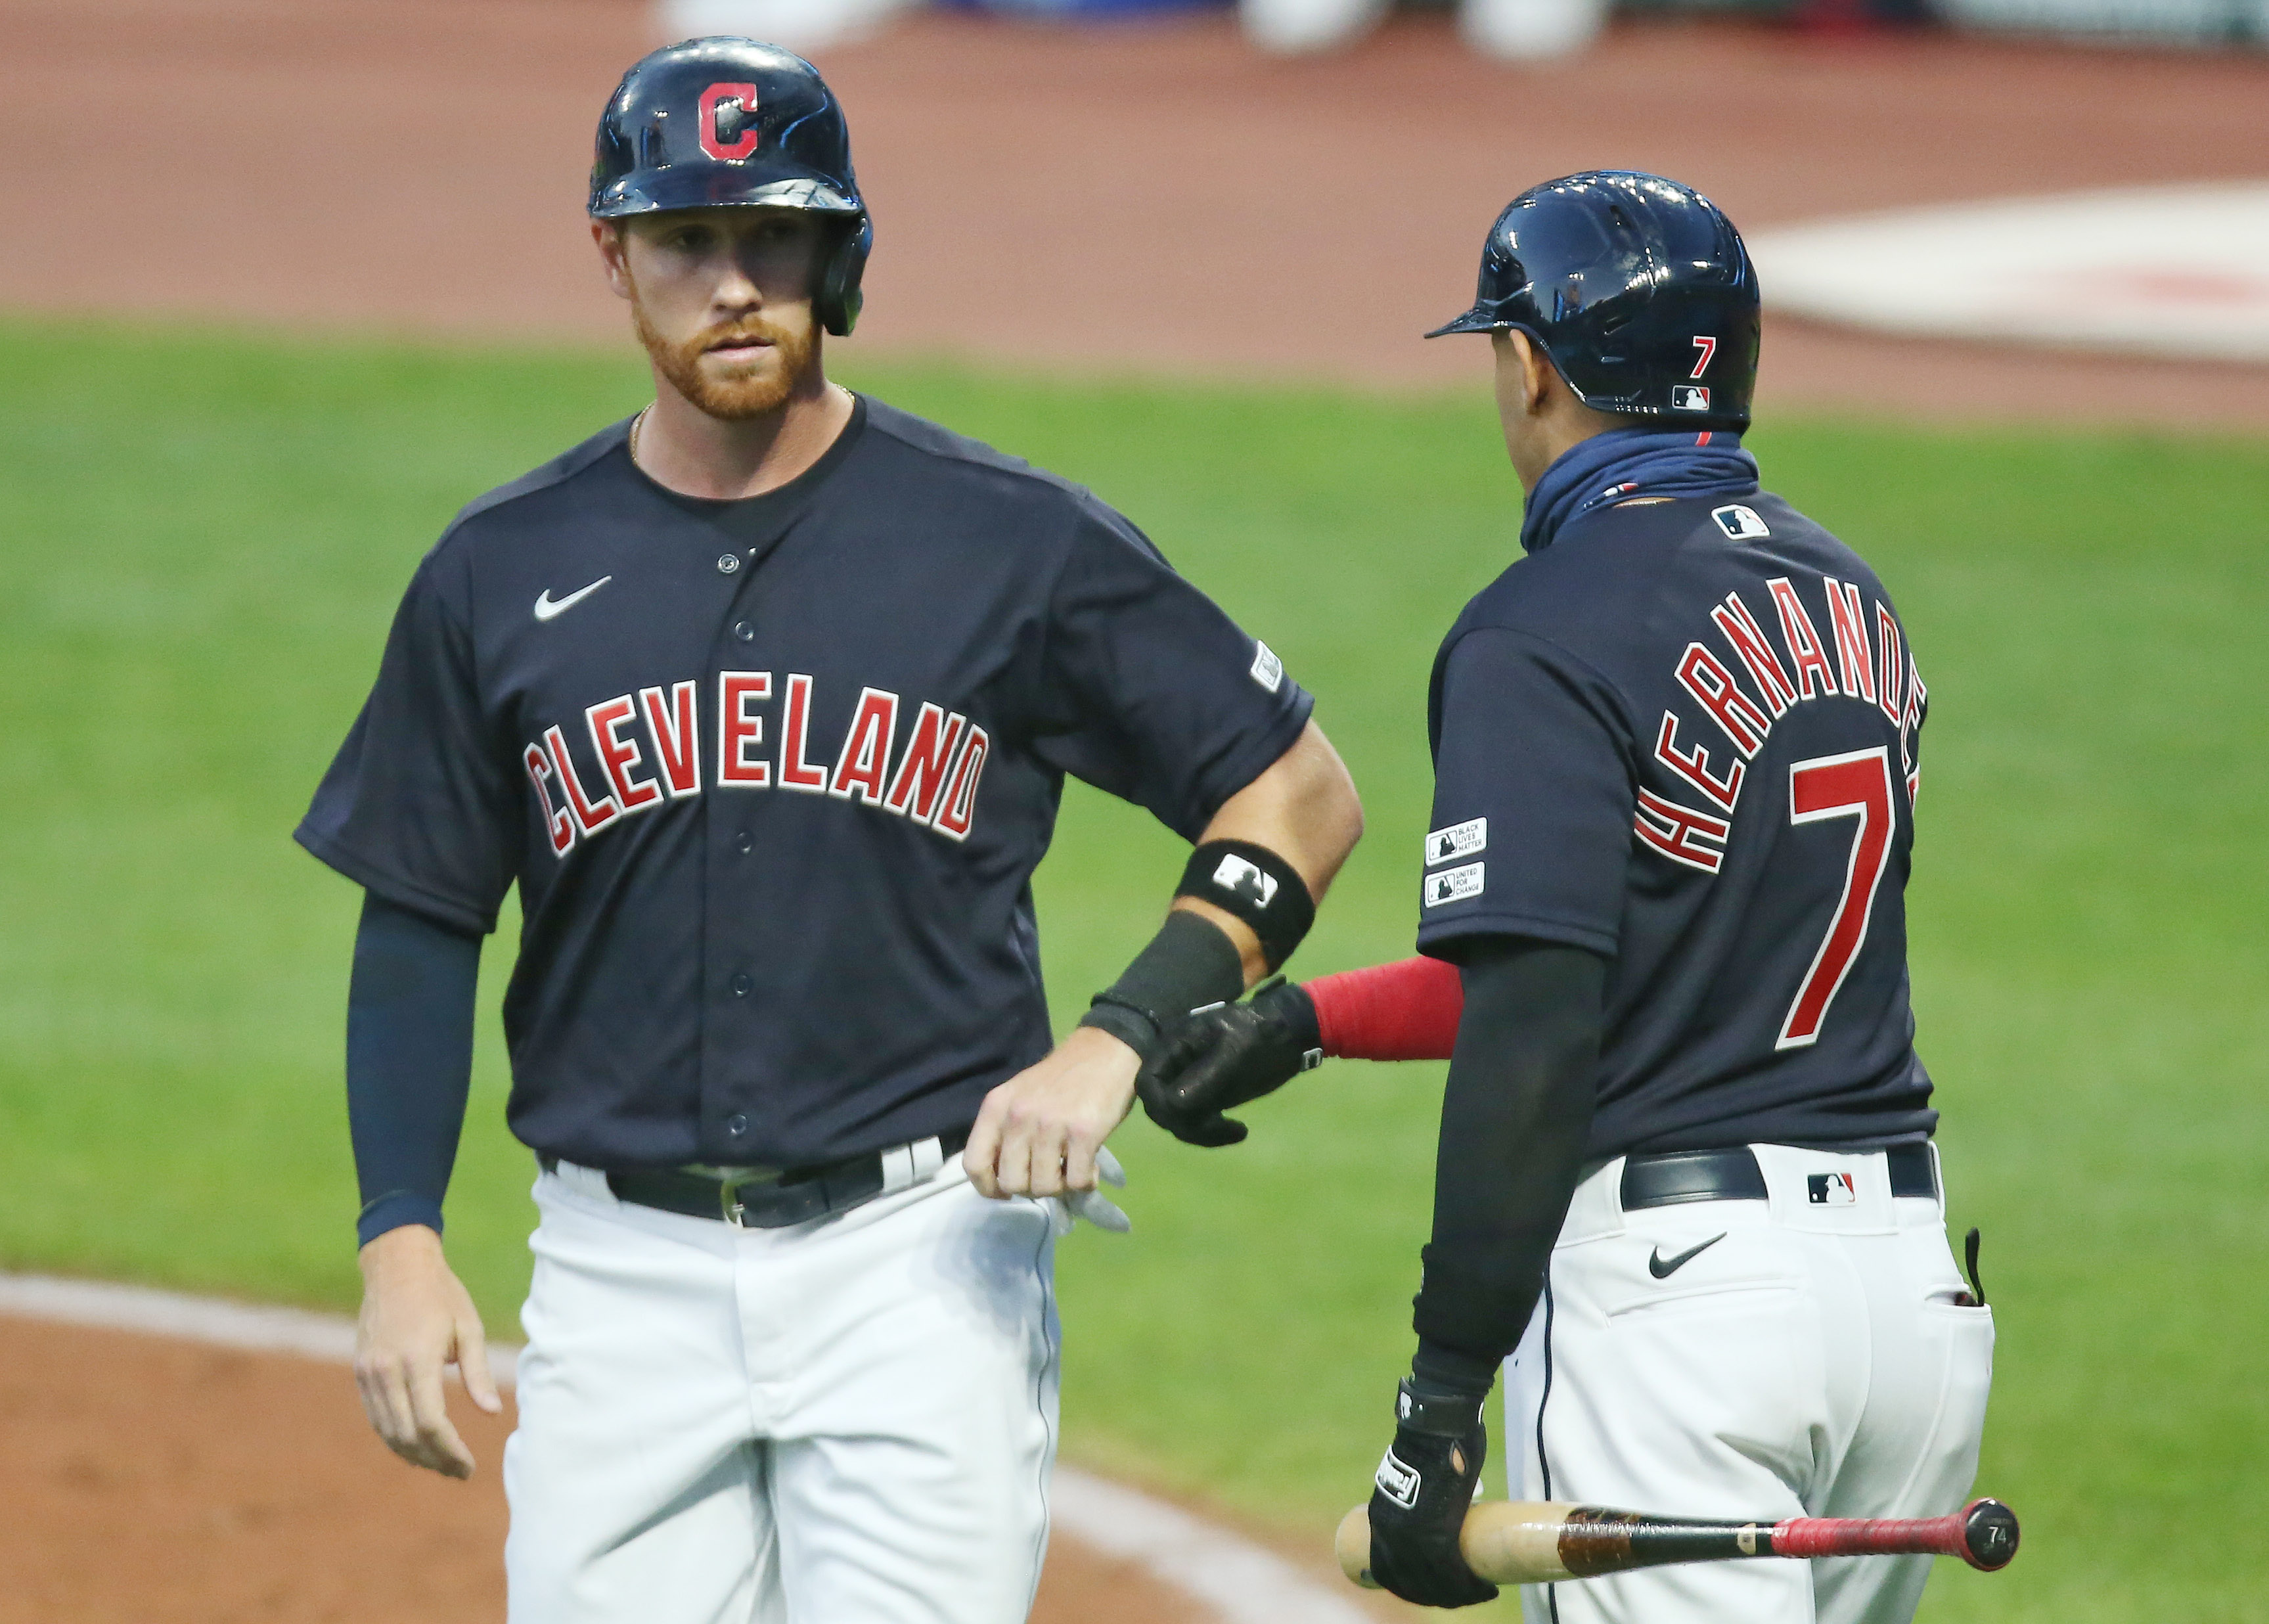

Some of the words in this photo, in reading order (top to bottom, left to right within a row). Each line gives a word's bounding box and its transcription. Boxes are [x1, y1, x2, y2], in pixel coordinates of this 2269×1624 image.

[698, 82, 758, 162] C
[1689, 335, 1717, 379] 7
[523, 670, 990, 859] CLEVELAND
[1458, 824, 1479, 835] BLACK
[1458, 832, 1475, 843] LIVES
[1458, 839, 1482, 851] MATTER
[1456, 868, 1477, 878] UNITED
[1456, 878, 1468, 887] FOR
[1456, 884, 1479, 895] CHANGE
[1774, 744, 1897, 1050] 7
